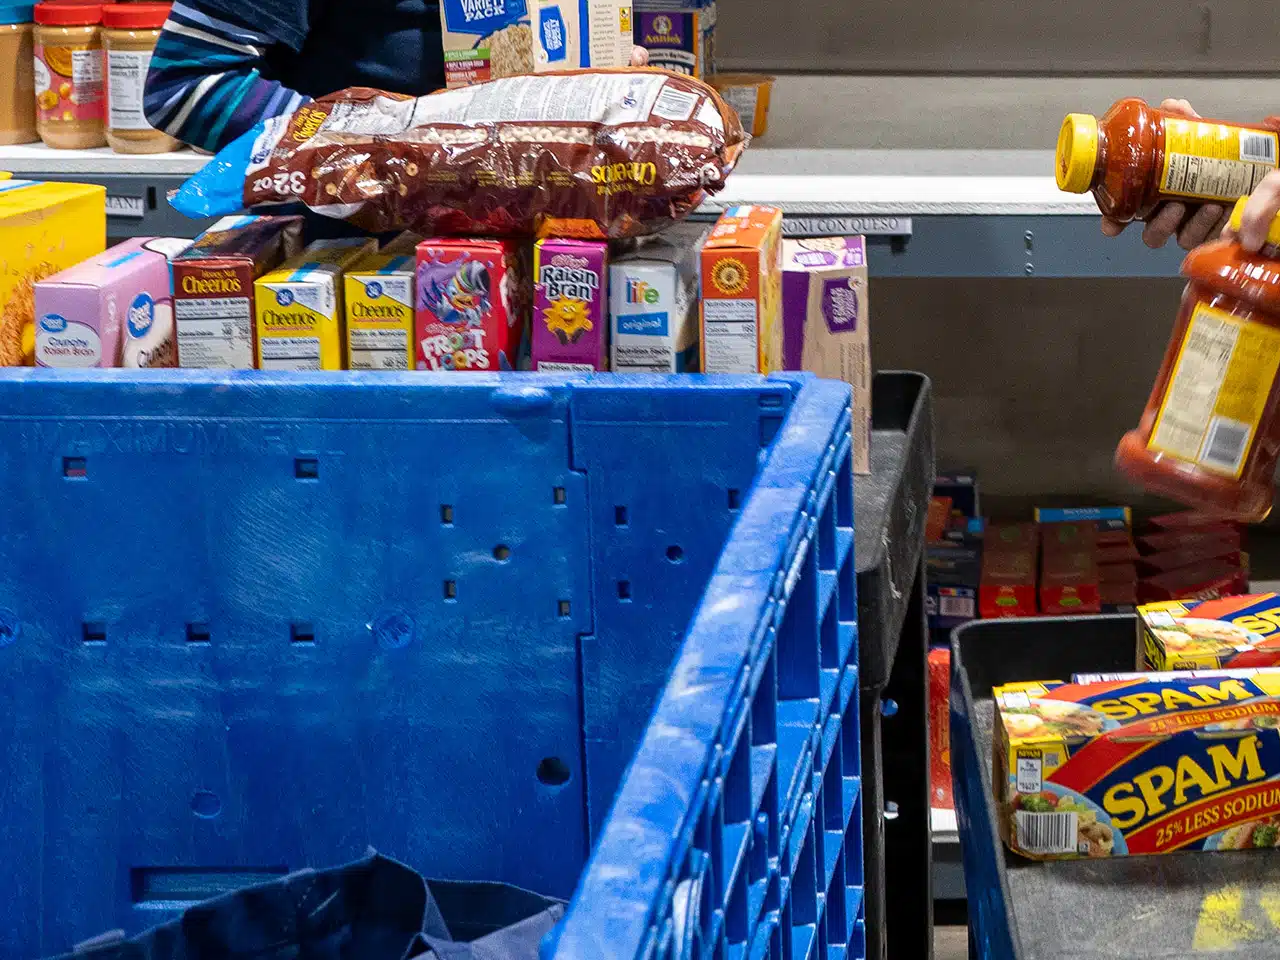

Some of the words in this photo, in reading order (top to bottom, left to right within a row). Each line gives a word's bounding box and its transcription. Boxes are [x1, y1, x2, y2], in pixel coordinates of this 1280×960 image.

[465, 6, 506, 23] PACK
[252, 176, 273, 192] oz
[273, 171, 306, 195] 32
[591, 161, 657, 185] Cheerios
[818, 219, 847, 232] CON
[851, 217, 899, 233] QUESO
[182, 276, 242, 294] Cheerios
[541, 266, 599, 289] Raisin
[547, 282, 593, 301] Bran
[626, 277, 660, 304] life
[263, 308, 317, 326] Cheerios
[351, 301, 406, 318] Cheerios
[622, 317, 663, 330] original
[421, 328, 487, 356] FROOT
[429, 348, 491, 371] LOOPS
[1091, 679, 1255, 721] SPAM
[1177, 711, 1212, 726] LESS
[1213, 703, 1280, 721] SODIUM
[1103, 735, 1267, 829] SPAM
[1155, 820, 1183, 848] 25%
[1185, 808, 1220, 836] LESS
